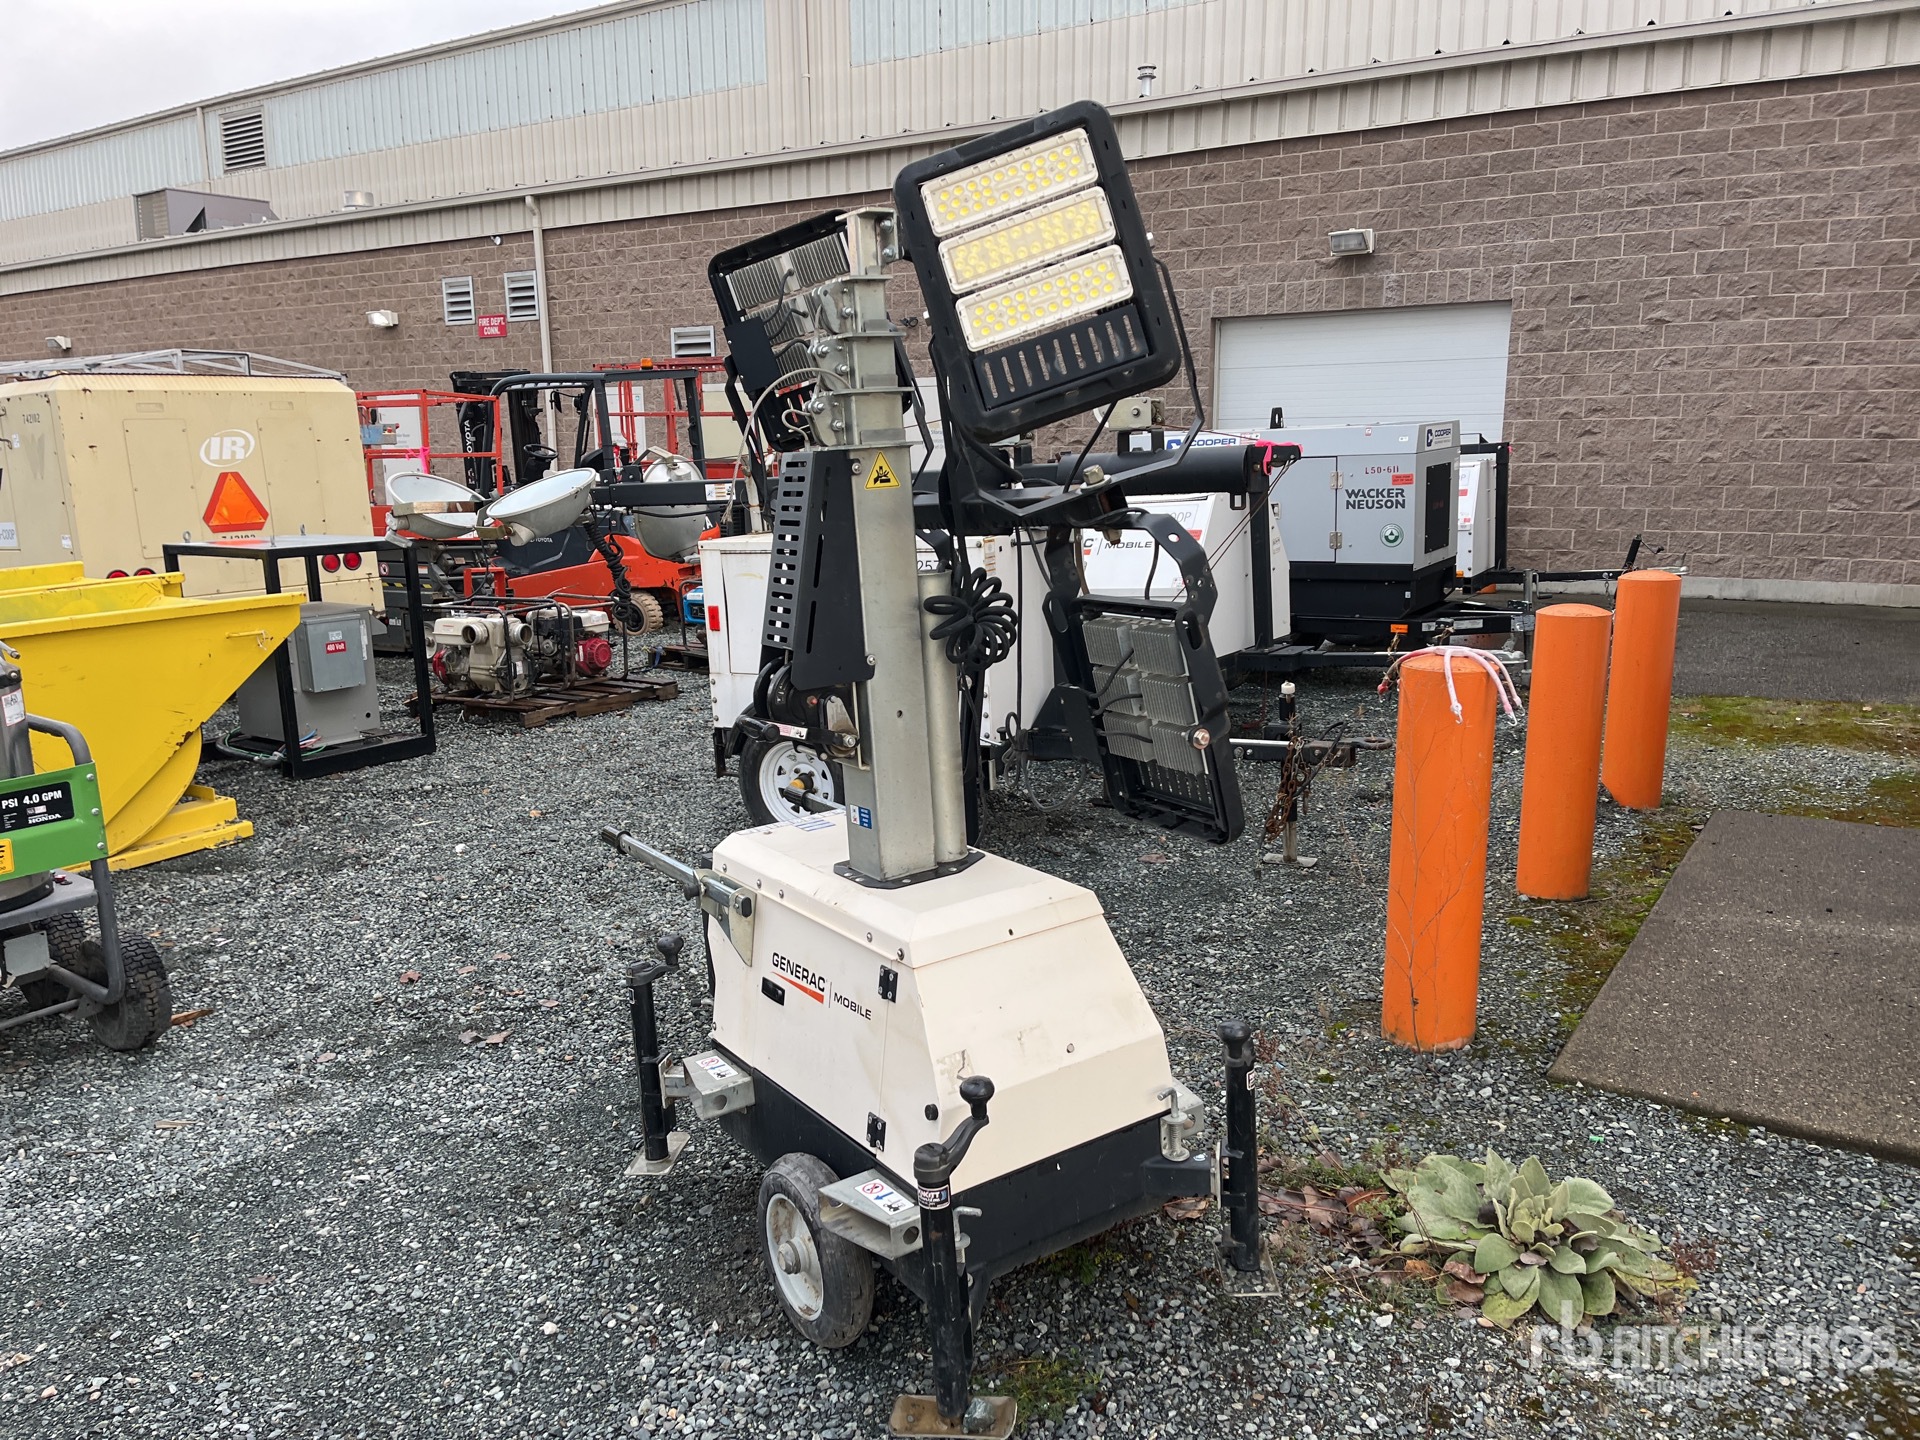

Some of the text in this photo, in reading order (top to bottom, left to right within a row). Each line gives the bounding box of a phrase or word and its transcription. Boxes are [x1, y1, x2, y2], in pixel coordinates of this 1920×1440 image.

[478, 318, 490, 326] FIRE
[483, 327, 501, 335] CONN.
[1435, 428, 1451, 437] COOPER
[464, 420, 473, 459] OYOTA
[1190, 438, 1237, 447] COOPER
[209, 436, 247, 460] IR
[1345, 488, 1406, 499] WACKER
[1345, 499, 1406, 510] NEUSON
[1105, 541, 1153, 549] MOBILE
[2, 789, 63, 809] PSI 4.0 GPM
[28, 813, 62, 824] HONDA
[772, 952, 872, 1020] GENERAC MOBILE
